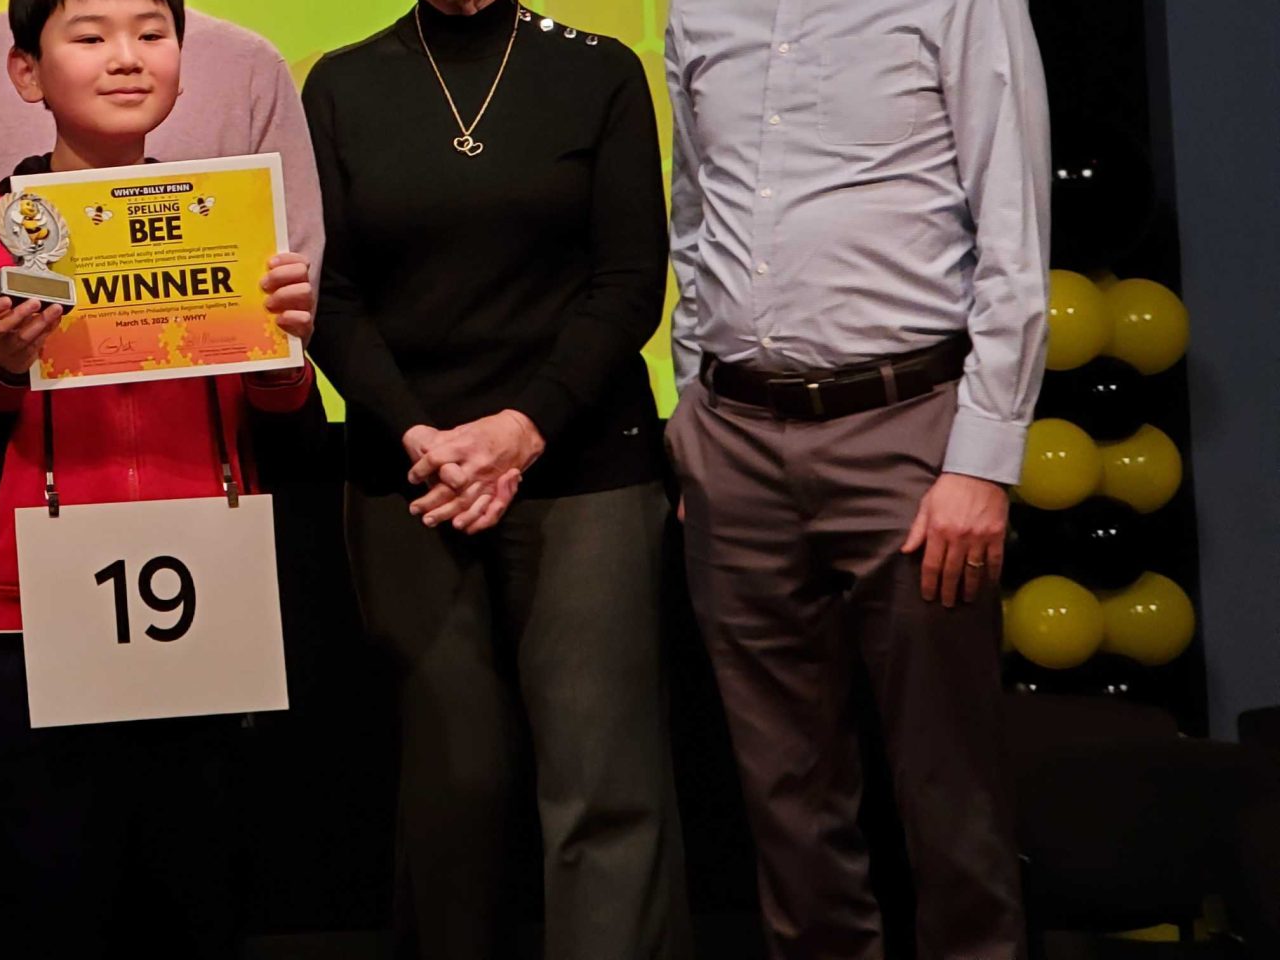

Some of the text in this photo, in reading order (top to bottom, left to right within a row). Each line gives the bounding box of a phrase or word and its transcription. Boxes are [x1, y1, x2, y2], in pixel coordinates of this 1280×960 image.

[114, 184, 190, 197] WHYY-BILLY PENN
[127, 202, 180, 215] SPELLING
[129, 215, 183, 244] BEE
[81, 266, 234, 304] WINNER
[116, 319, 139, 327] March
[152, 317, 169, 325] 2025
[183, 313, 207, 321] WHYY
[94, 555, 197, 644] 19
